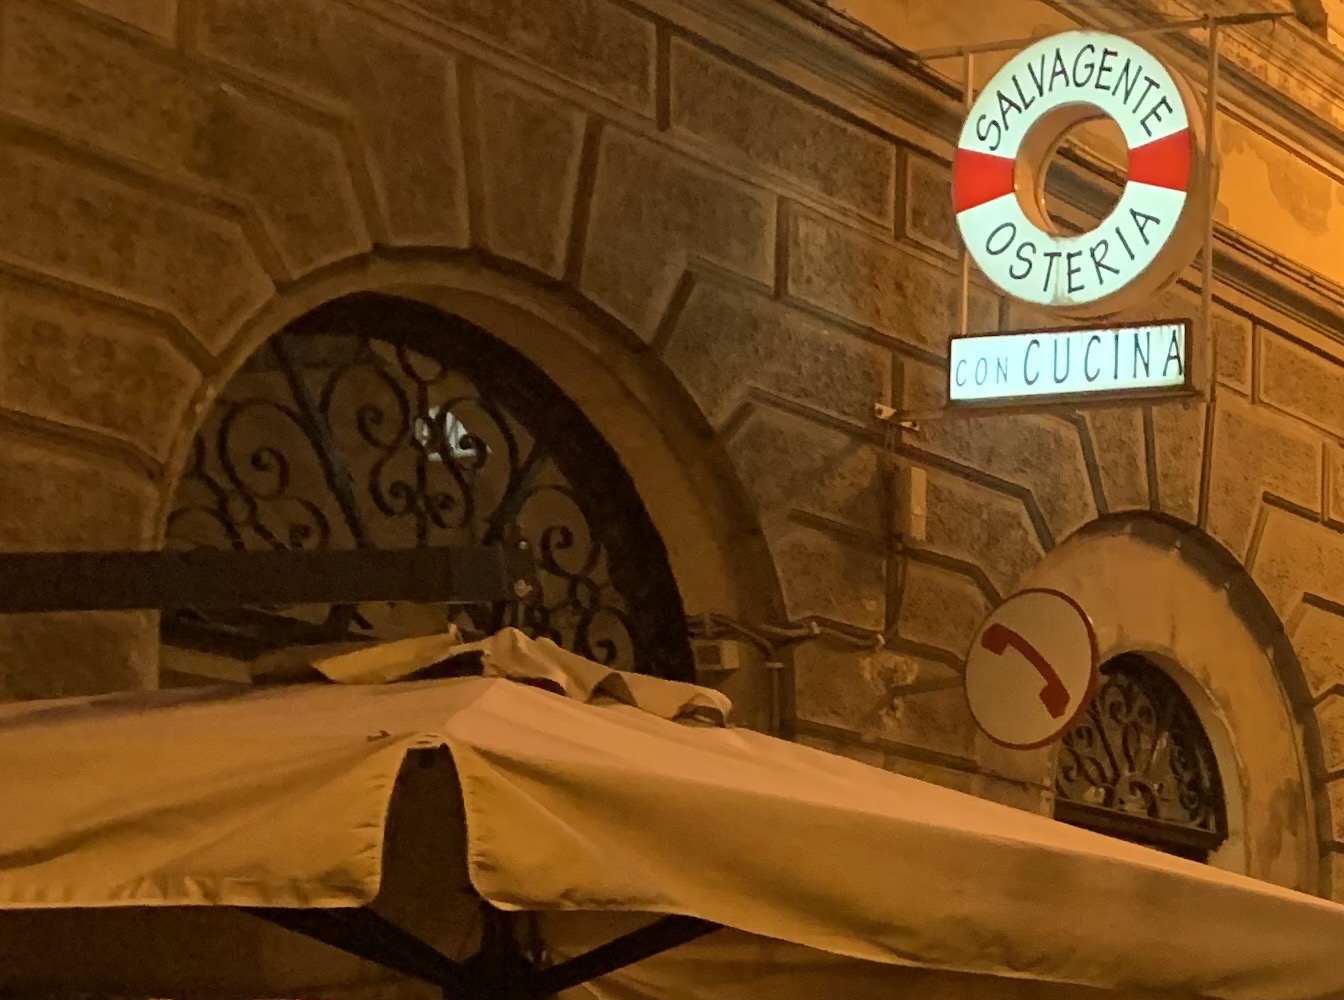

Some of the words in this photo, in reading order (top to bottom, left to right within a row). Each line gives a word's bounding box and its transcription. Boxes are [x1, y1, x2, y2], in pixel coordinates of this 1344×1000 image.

[976, 43, 1173, 151] SALVAGENTE
[985, 207, 1161, 294] OSTERIA
[955, 356, 1008, 387] CON
[1023, 330, 1183, 385] CUCINA
